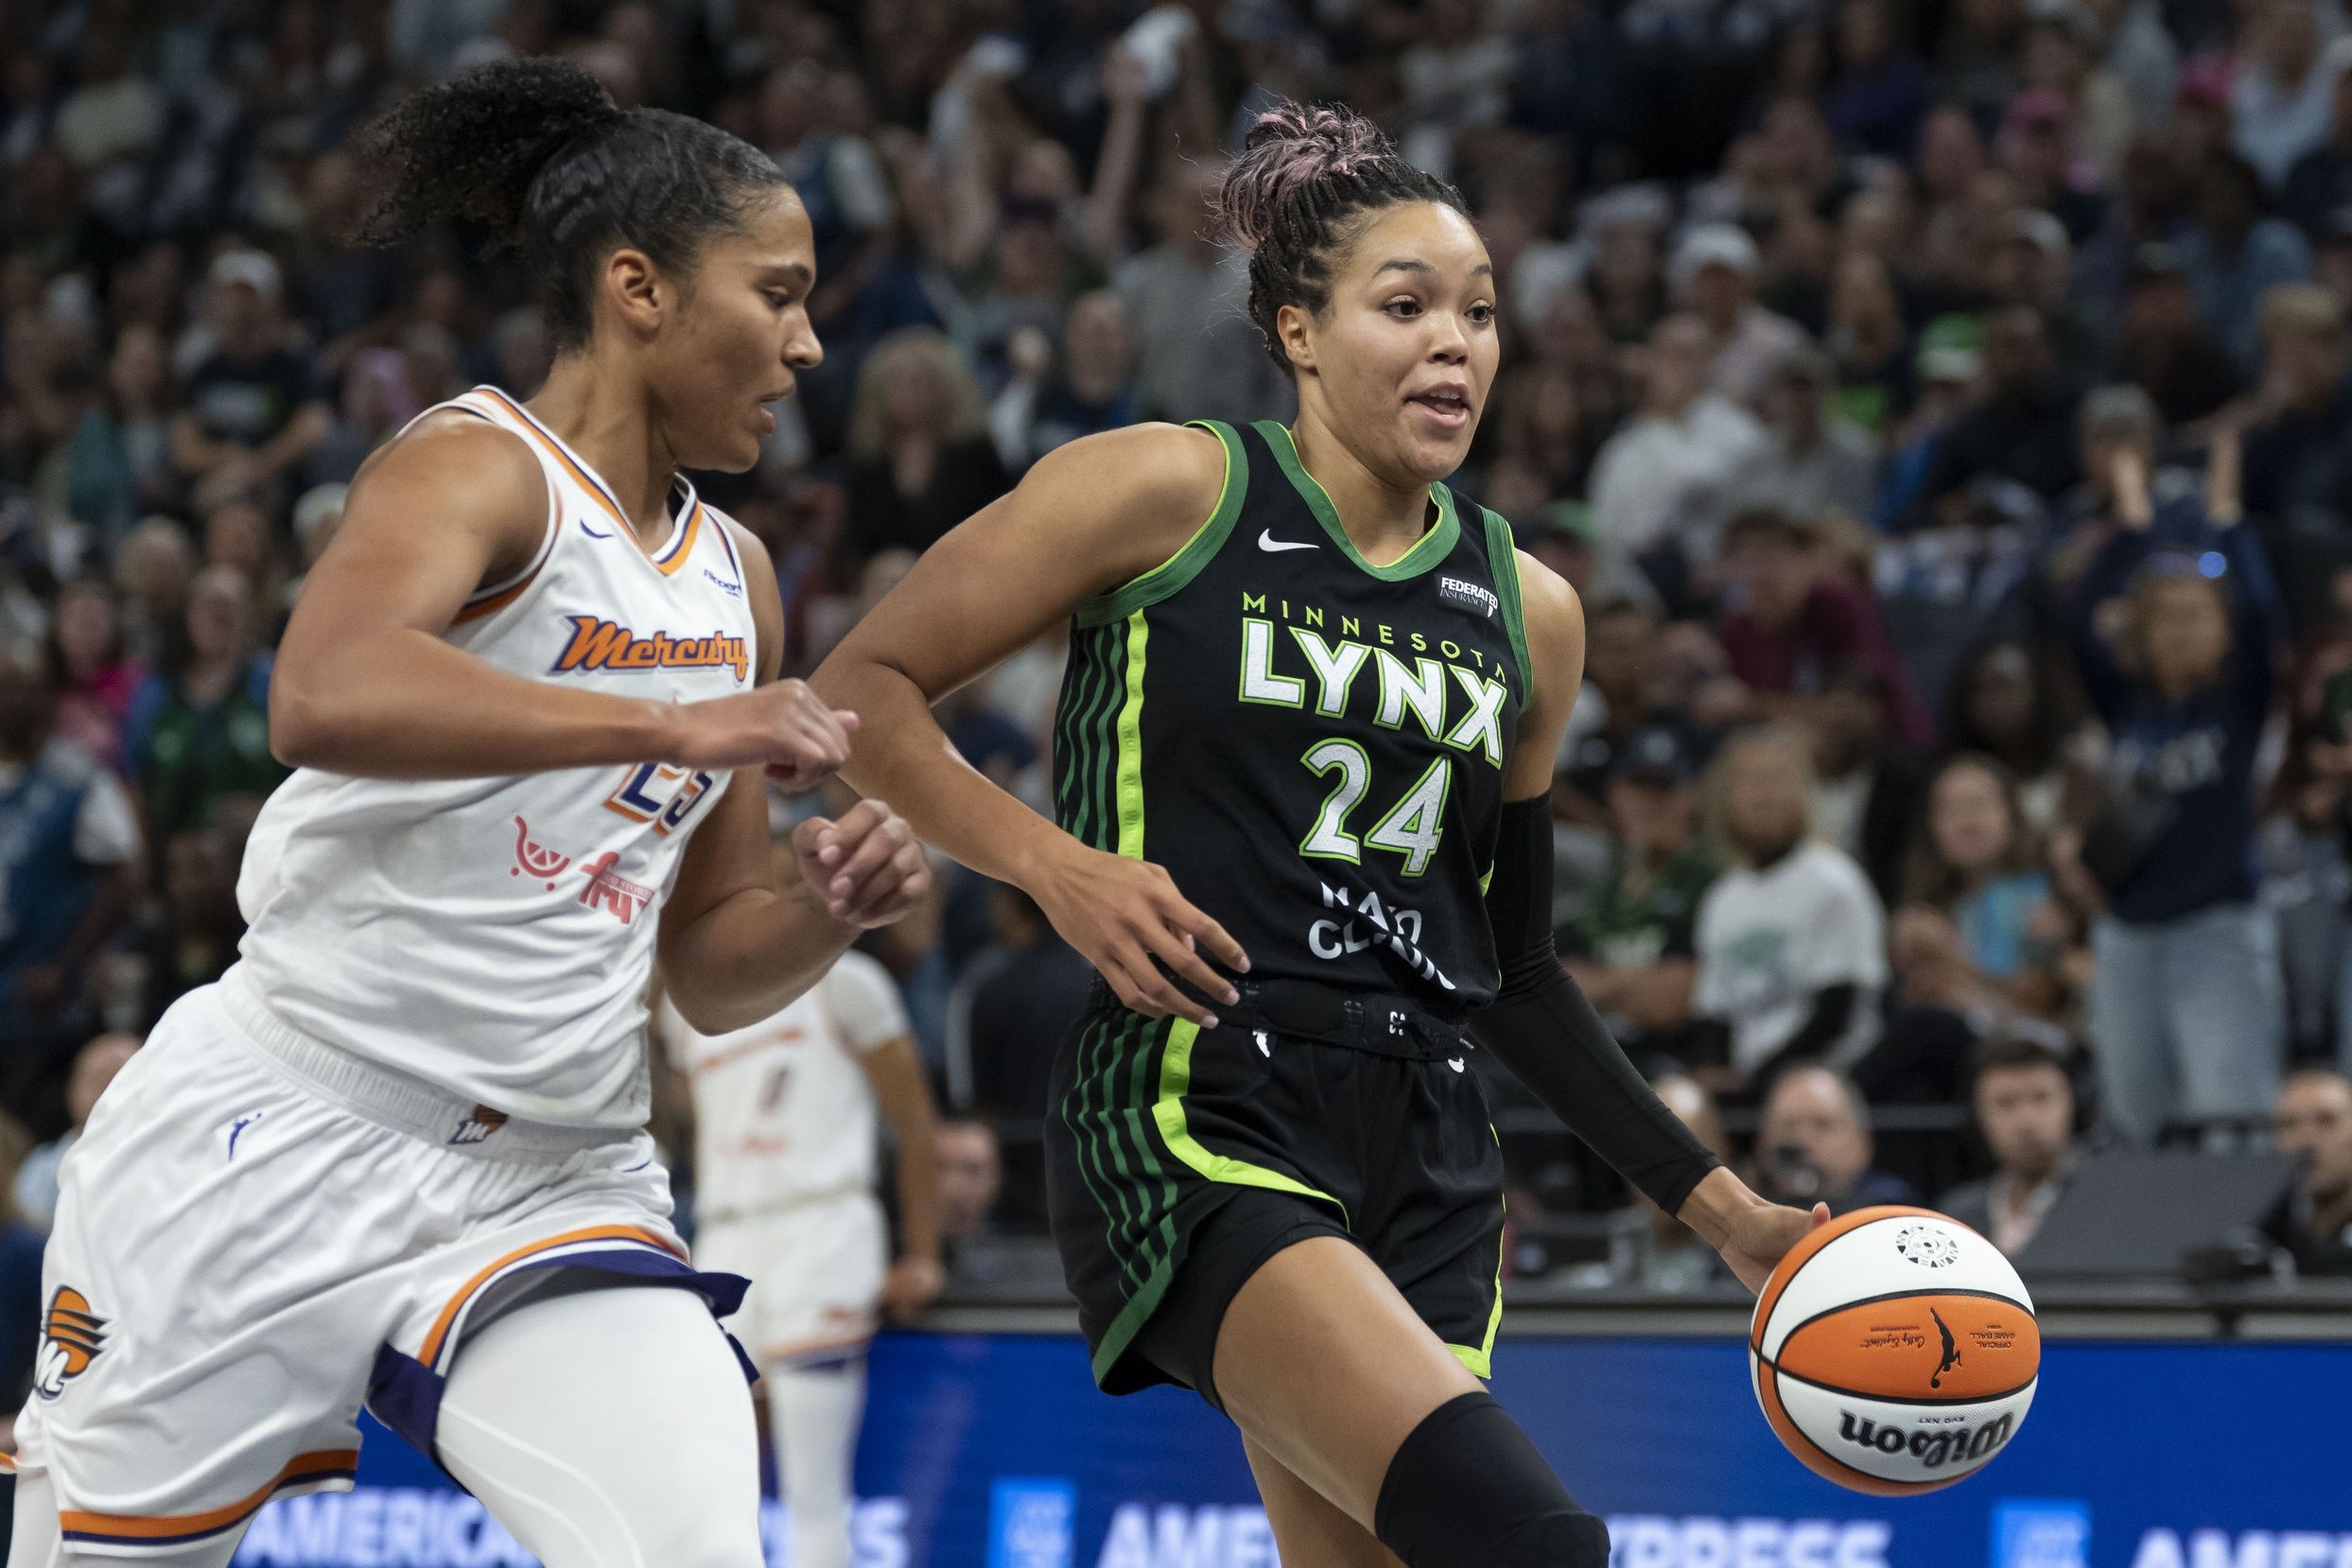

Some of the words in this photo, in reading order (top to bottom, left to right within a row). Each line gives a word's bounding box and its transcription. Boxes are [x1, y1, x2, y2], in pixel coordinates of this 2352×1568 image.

[1441, 576, 1498, 610] FEDERATED
[552, 616, 749, 683] Mercury
[1243, 591, 1507, 684] MINNESOTA
[1238, 617, 1508, 770] LYNX
[1298, 737, 1452, 877] 24
[1838, 1407, 2014, 1468] Wilson
[235, 1487, 546, 1568] AMERICA
